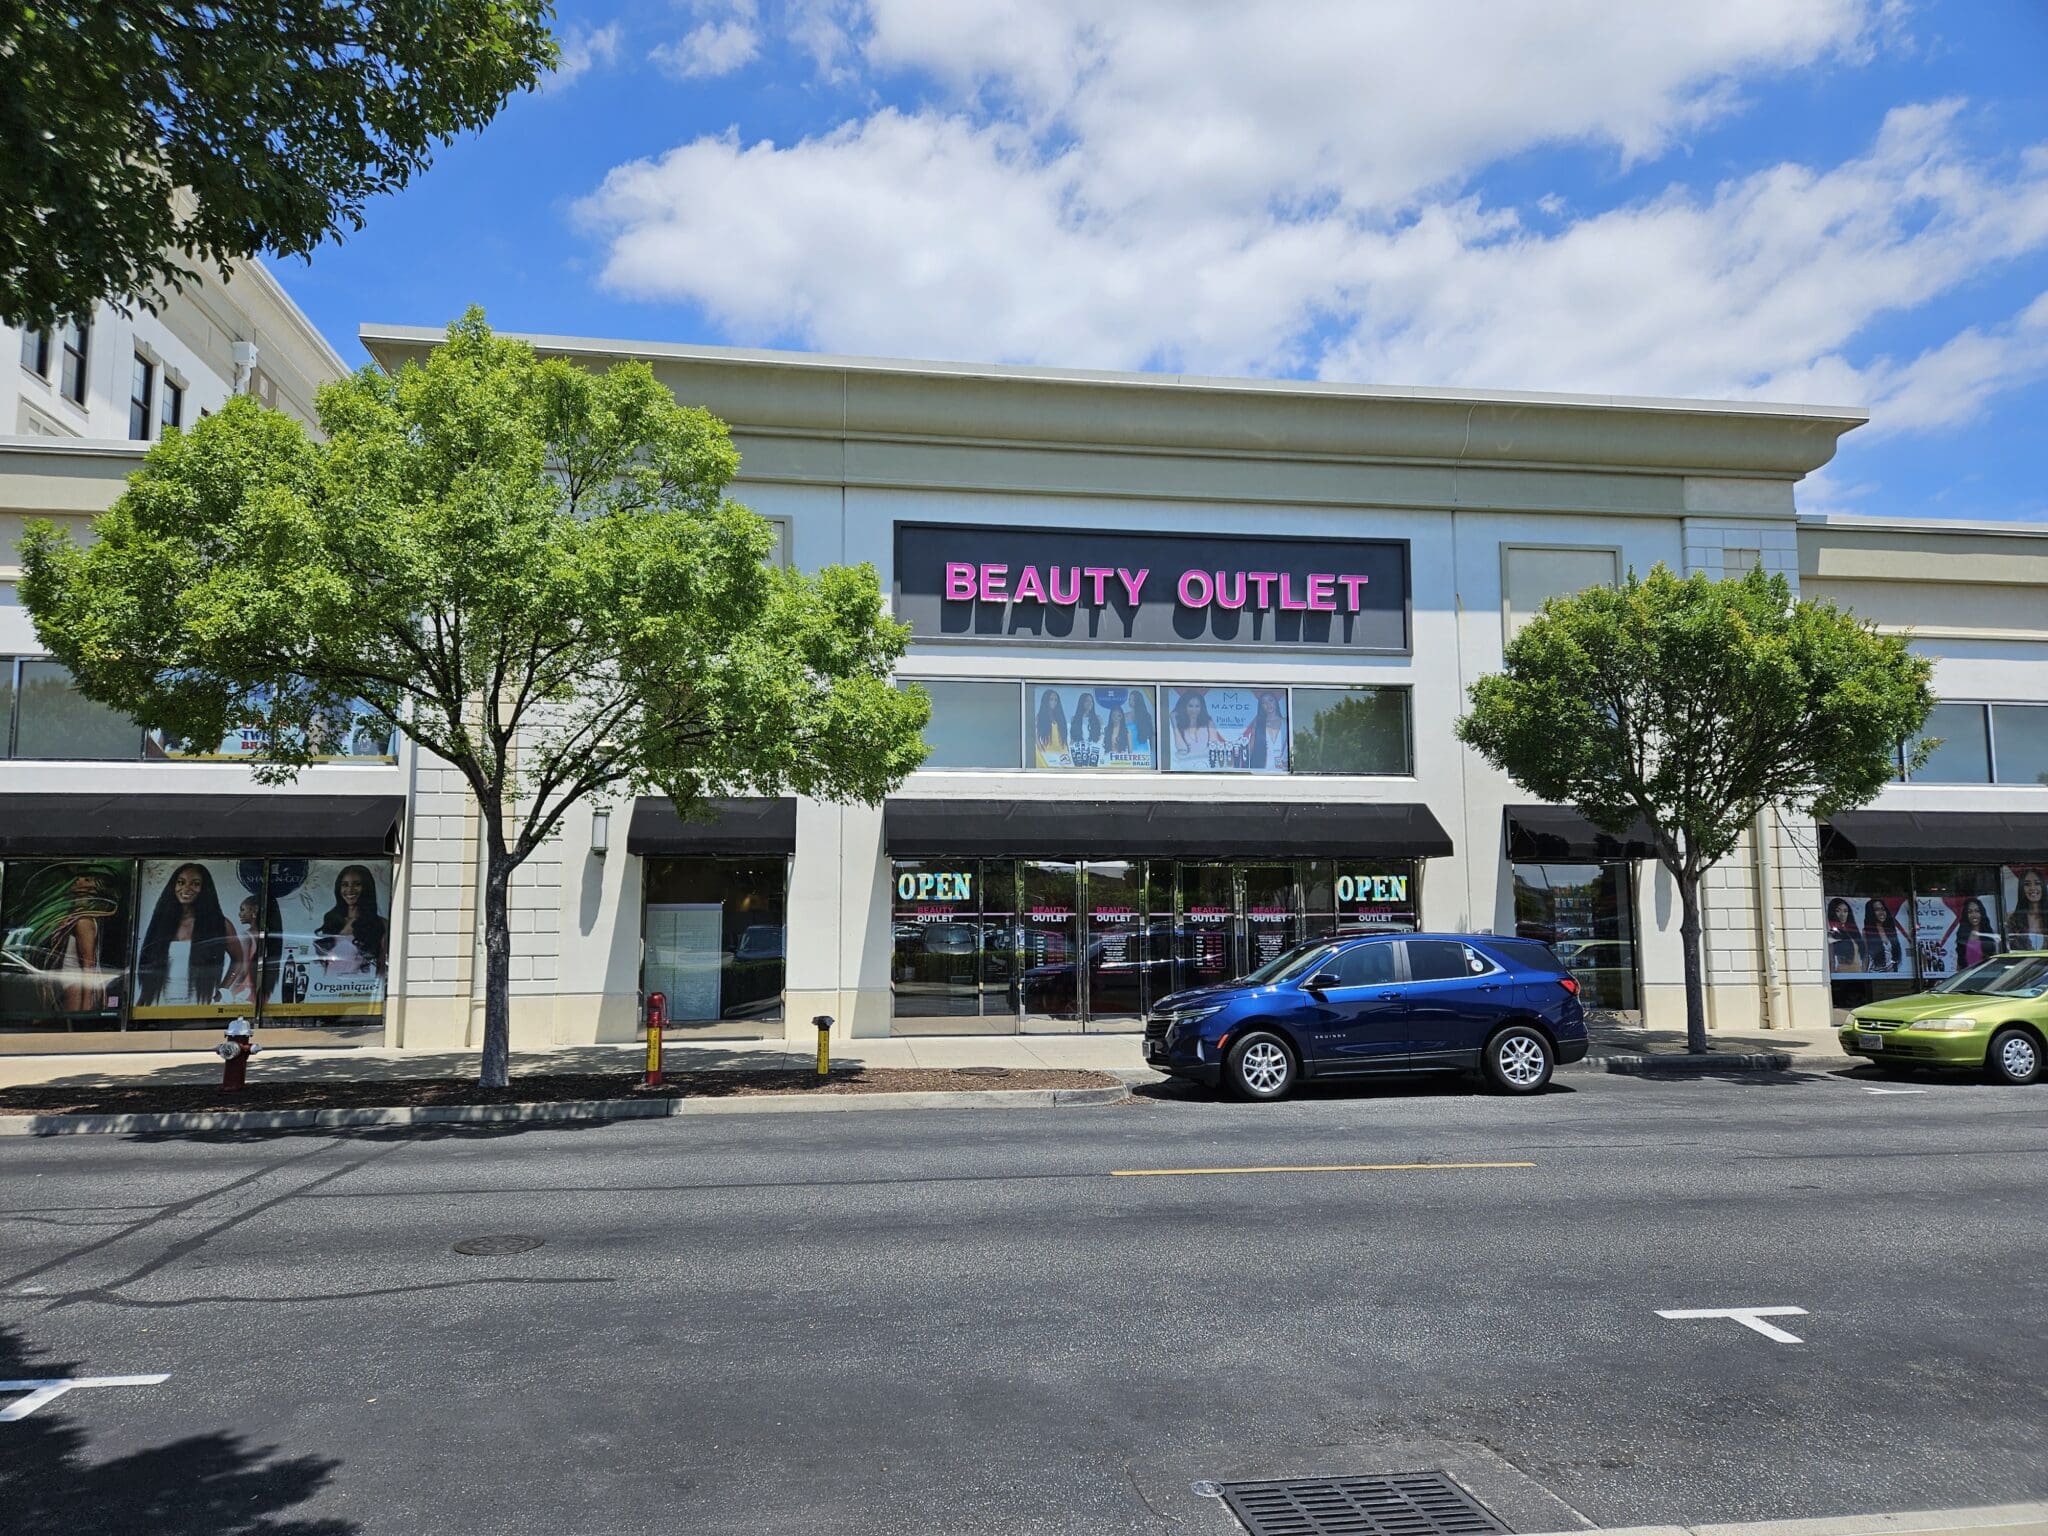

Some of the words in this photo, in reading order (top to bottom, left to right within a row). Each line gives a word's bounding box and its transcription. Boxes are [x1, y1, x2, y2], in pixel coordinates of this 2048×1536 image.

[946, 562, 1149, 606] BEAUTY
[1177, 569, 1369, 611] OUTLET
[898, 873, 972, 900] OPEN
[1338, 875, 1407, 902] OPEN
[917, 914, 954, 922] OUTLET
[1032, 914, 1068, 922] OUTLET
[1096, 914, 1131, 922] OUTLET
[1191, 914, 1226, 922] OUTLET
[1252, 914, 1286, 922] OUTLET
[1359, 914, 1392, 922] OUTLET
